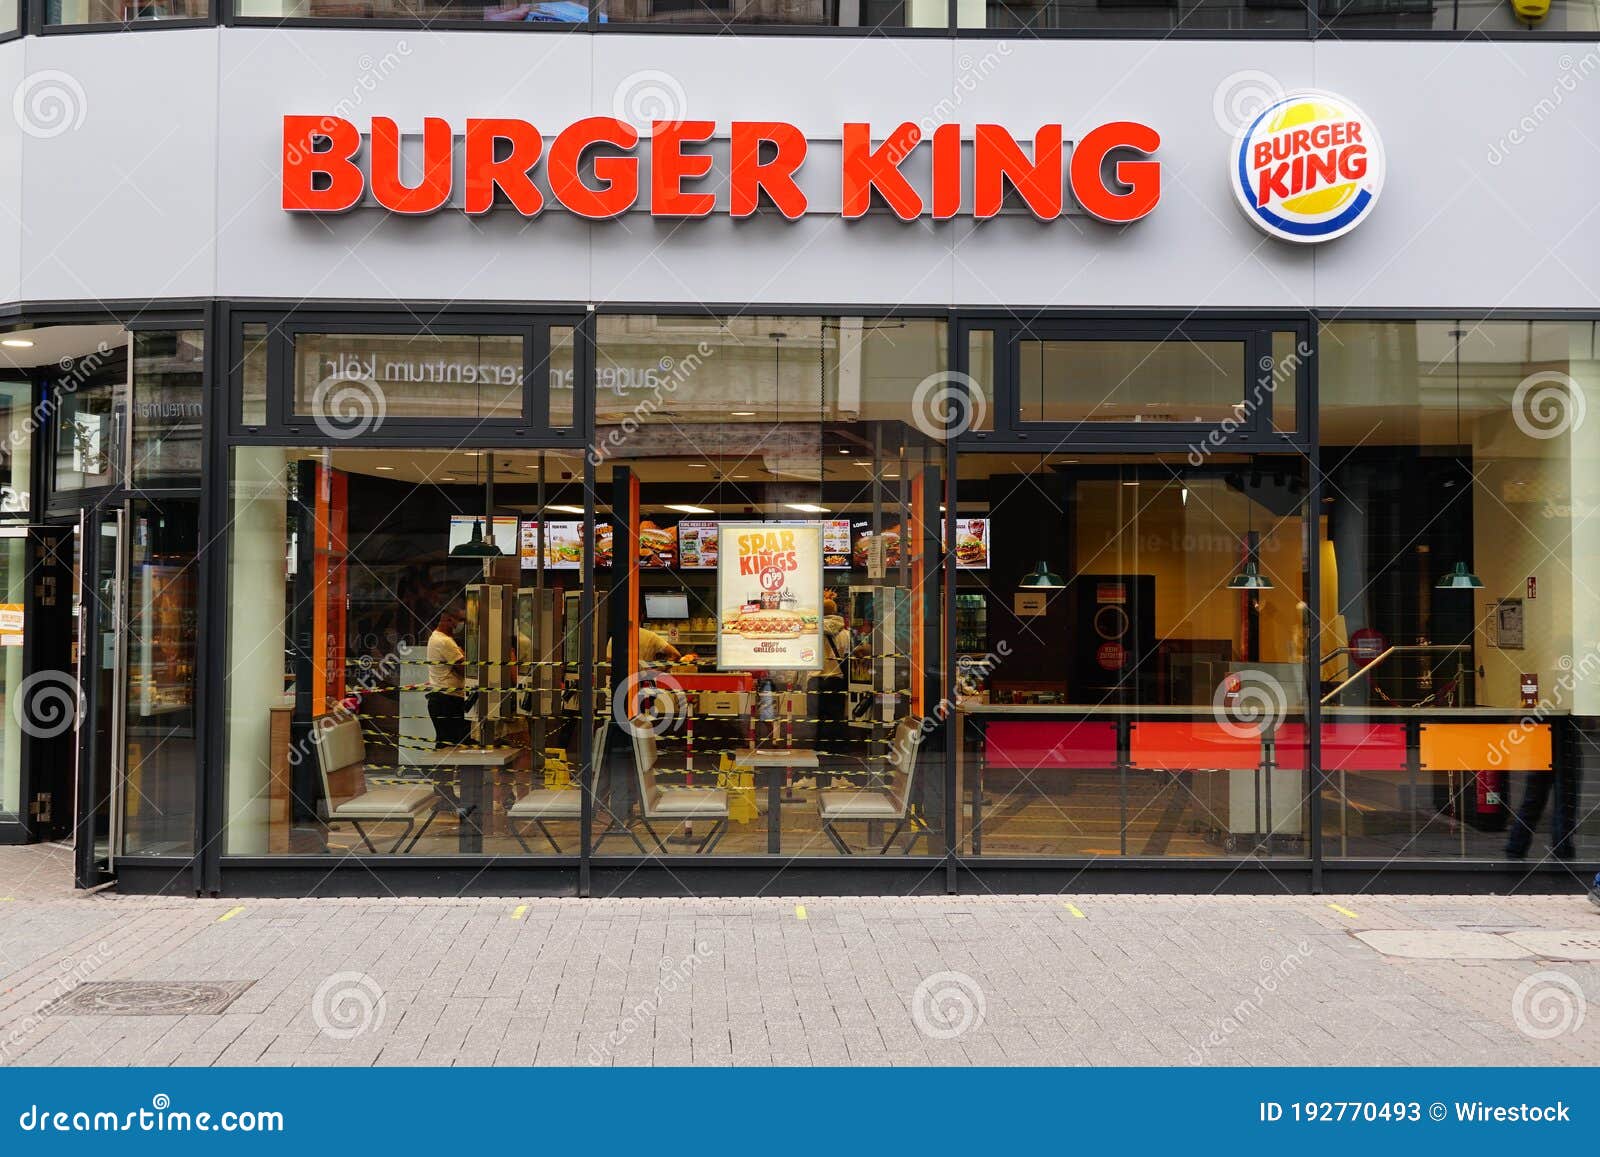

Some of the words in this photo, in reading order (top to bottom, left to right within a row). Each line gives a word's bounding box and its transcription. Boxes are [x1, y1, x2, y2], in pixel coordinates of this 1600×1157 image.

[282, 114, 808, 220] BURGER
[841, 120, 1161, 223] KING
[1254, 121, 1362, 170] BURGER
[1258, 145, 1367, 206] KING
[738, 531, 796, 555] SPAR
[740, 551, 798, 576] KINGS
